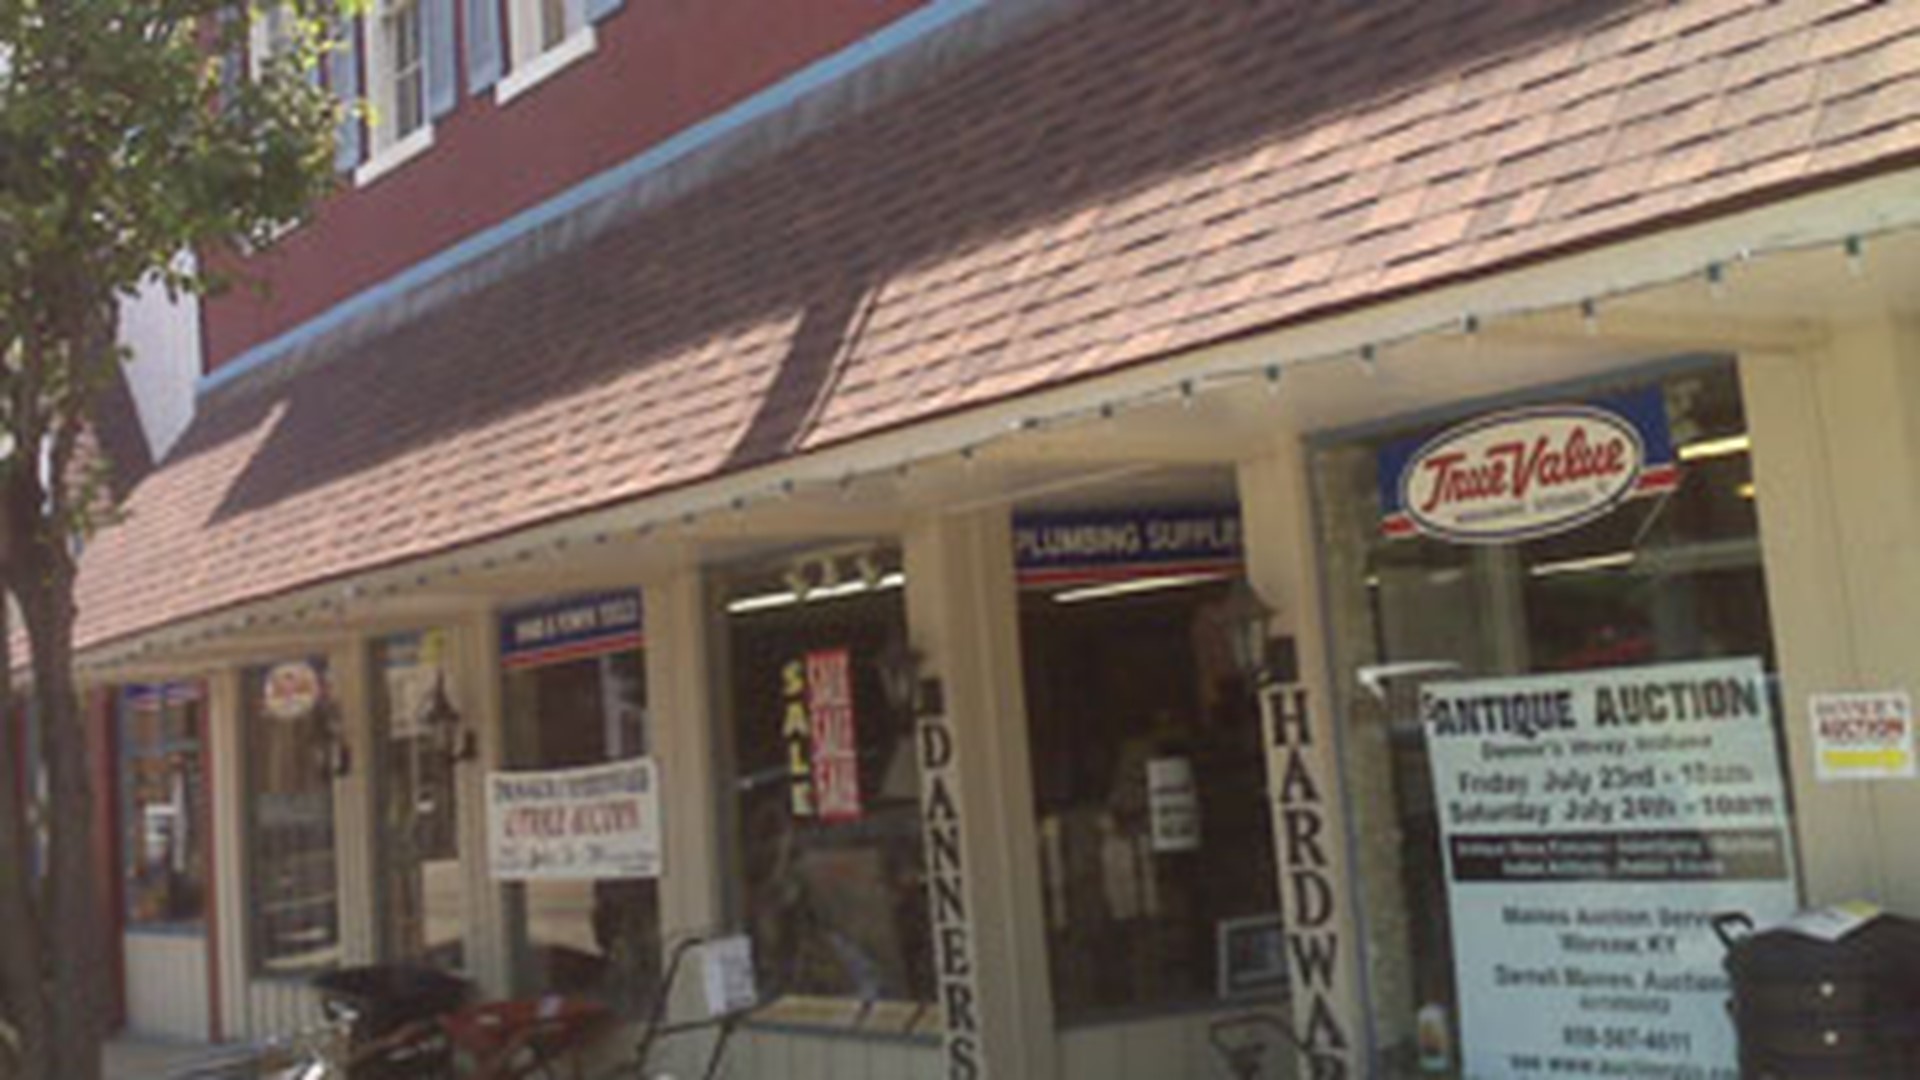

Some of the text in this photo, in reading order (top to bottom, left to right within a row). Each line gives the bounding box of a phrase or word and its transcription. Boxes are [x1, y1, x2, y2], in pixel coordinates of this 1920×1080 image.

[1486, 425, 1625, 498] Value
[781, 659, 814, 816] SALE
[1430, 677, 1760, 739] ANTIQUE AUCTION
[1449, 799, 1551, 826] Saturday
[1564, 797, 1614, 825] July
[1459, 769, 1529, 799] Friday
[1544, 767, 1593, 796] July
[921, 722, 978, 1080] DANNERS
